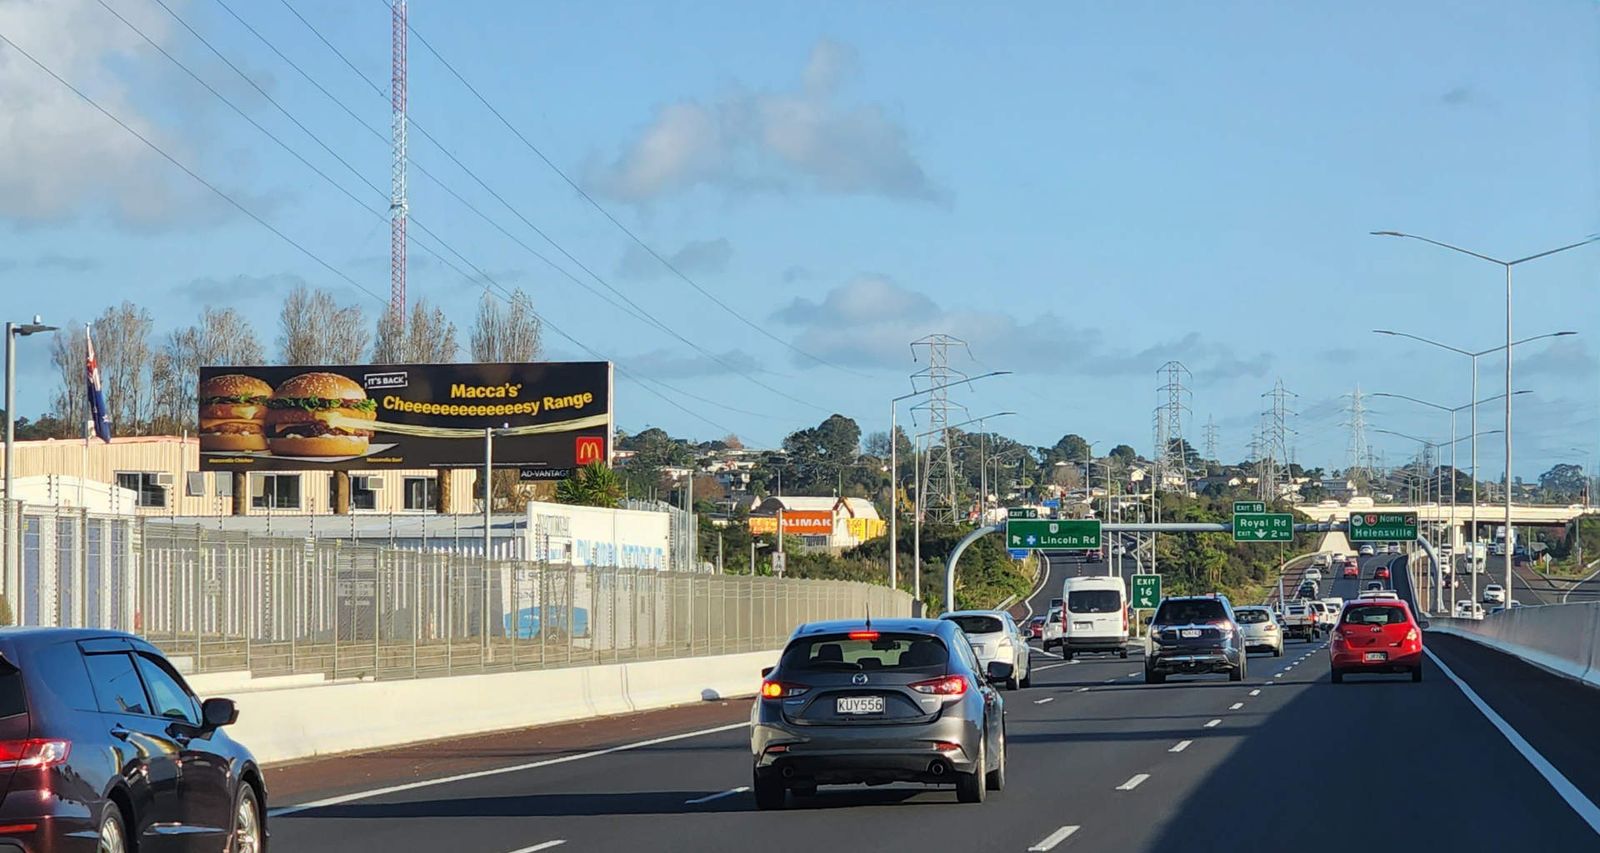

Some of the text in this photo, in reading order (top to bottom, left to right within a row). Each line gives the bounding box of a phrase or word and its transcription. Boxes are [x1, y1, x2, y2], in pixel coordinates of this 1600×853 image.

[367, 376, 404, 385] IT'S BACK
[543, 392, 593, 409] Range
[1026, 510, 1036, 518] 16
[781, 518, 832, 527] ALIMAK
[1240, 518, 1287, 529] Royal Rd
[1271, 530, 1278, 538] 2
[1355, 528, 1412, 537] Helensville
[1040, 536, 1096, 544] Lincoln Rd
[1136, 578, 1156, 586] EXIT
[1140, 587, 1153, 597] 16
[838, 699, 883, 711] KUY556
